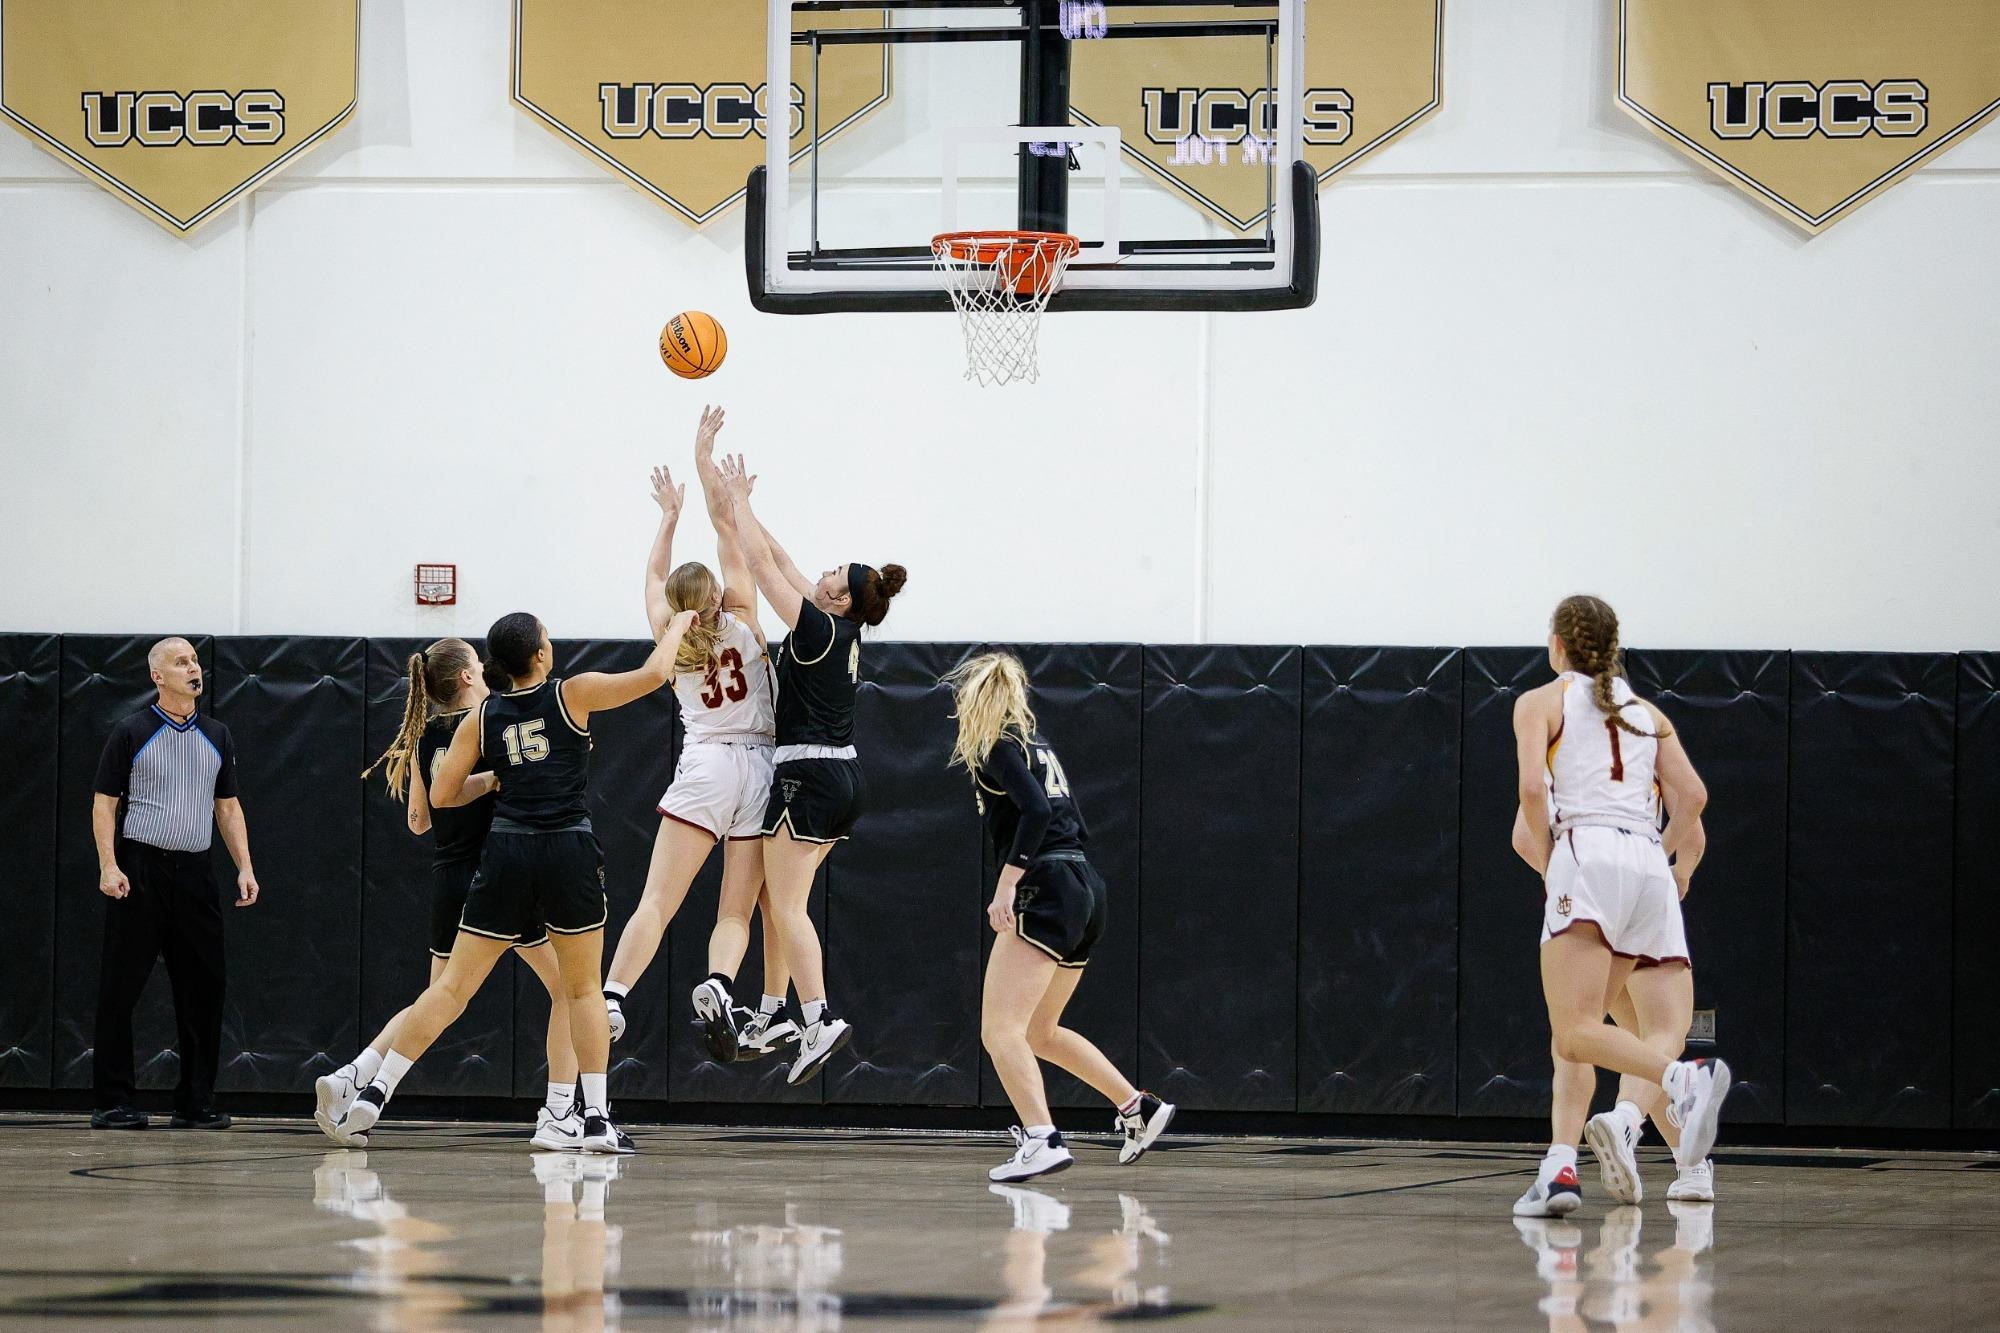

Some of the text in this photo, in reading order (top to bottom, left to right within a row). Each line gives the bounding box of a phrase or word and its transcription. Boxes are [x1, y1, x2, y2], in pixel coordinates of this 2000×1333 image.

[81, 89, 285, 147] UCCS
[599, 83, 804, 139] UCCS
[1707, 79, 1928, 139] UCCS
[694, 647, 748, 709] 33
[502, 718, 550, 766] 15
[1604, 716, 1624, 783] 1
